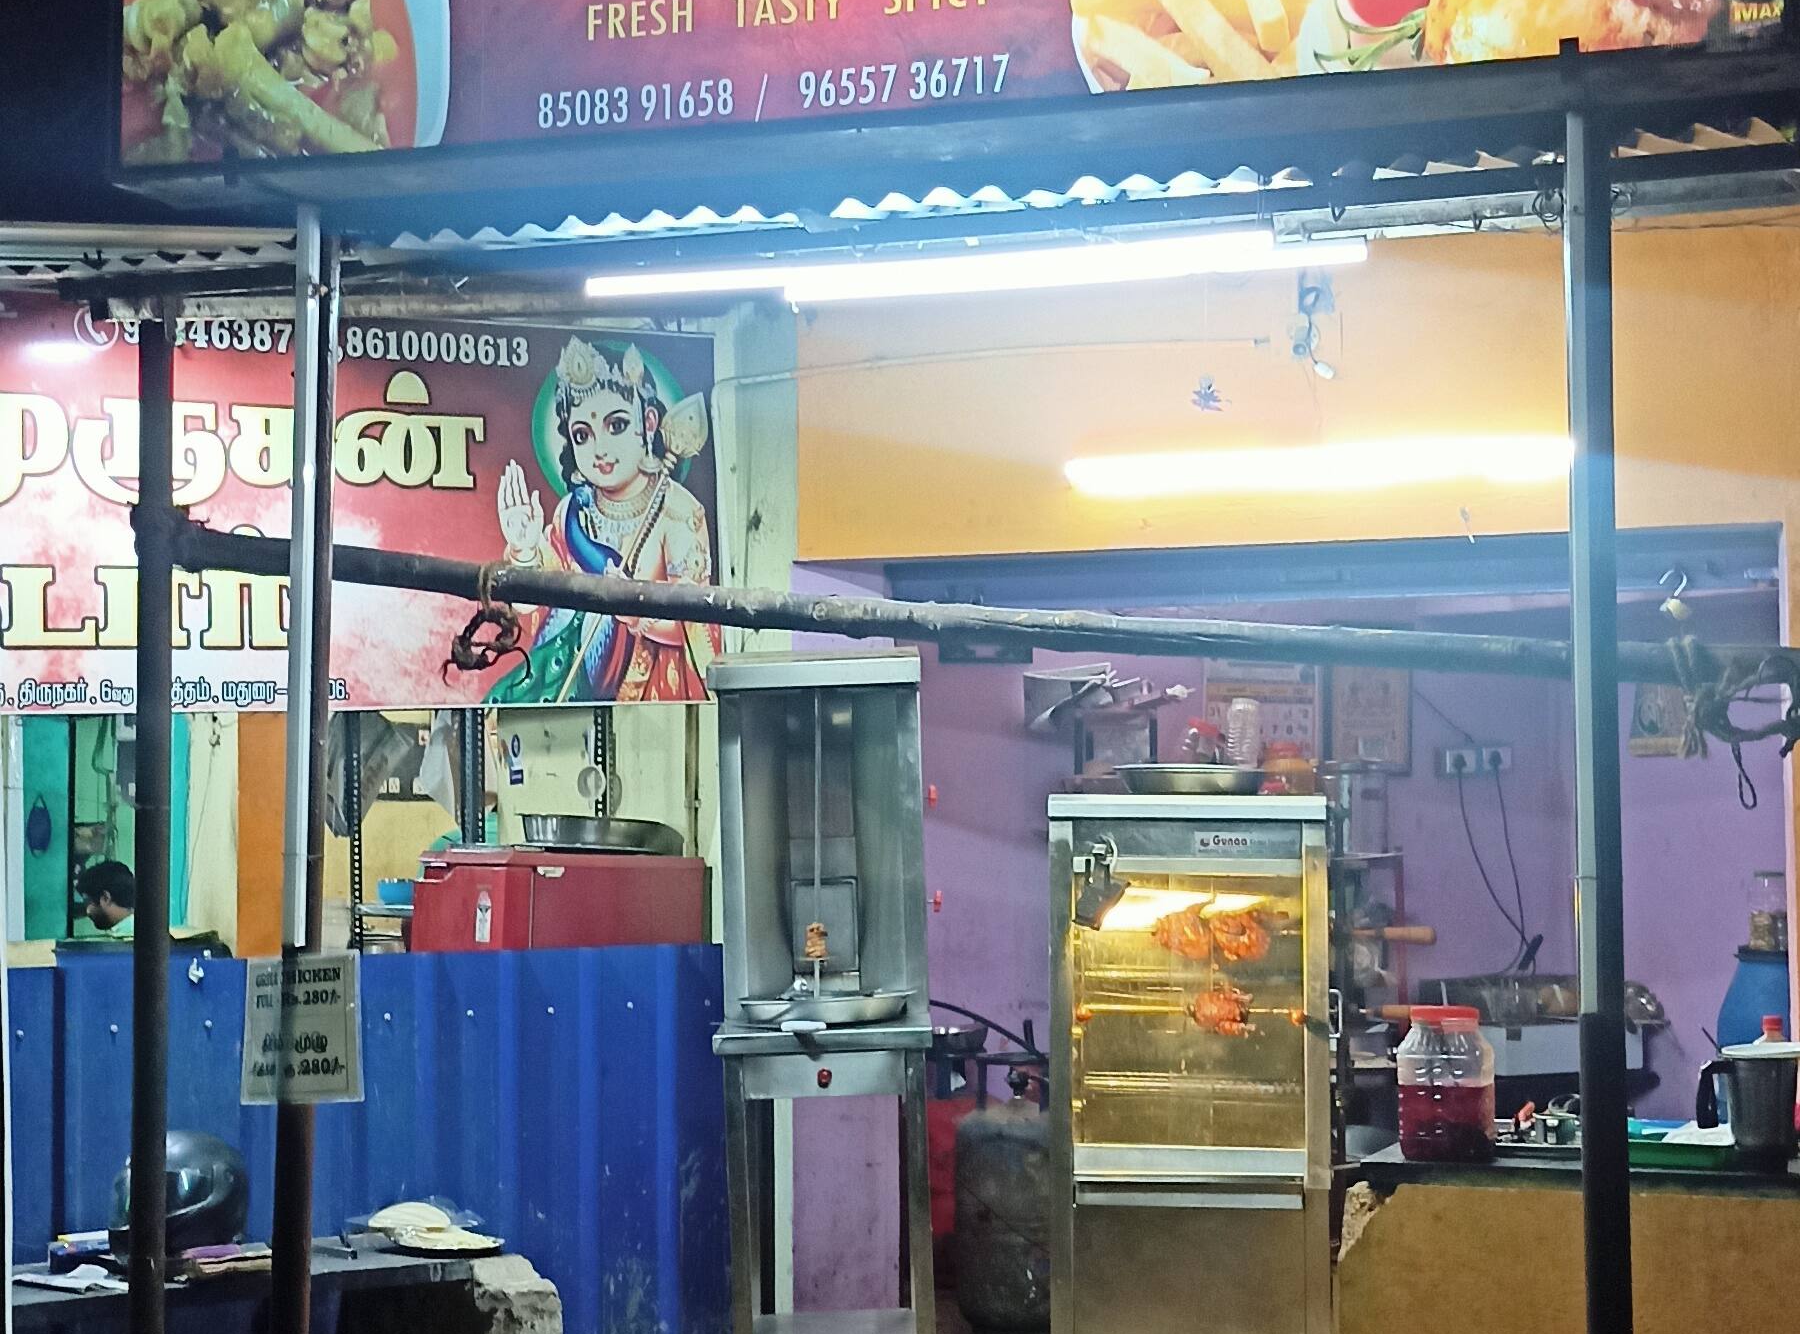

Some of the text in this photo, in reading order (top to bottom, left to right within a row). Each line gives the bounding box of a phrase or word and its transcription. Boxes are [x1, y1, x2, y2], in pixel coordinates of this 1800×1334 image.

[538, 52, 1011, 128] 85083 91658 / 96557 36717
